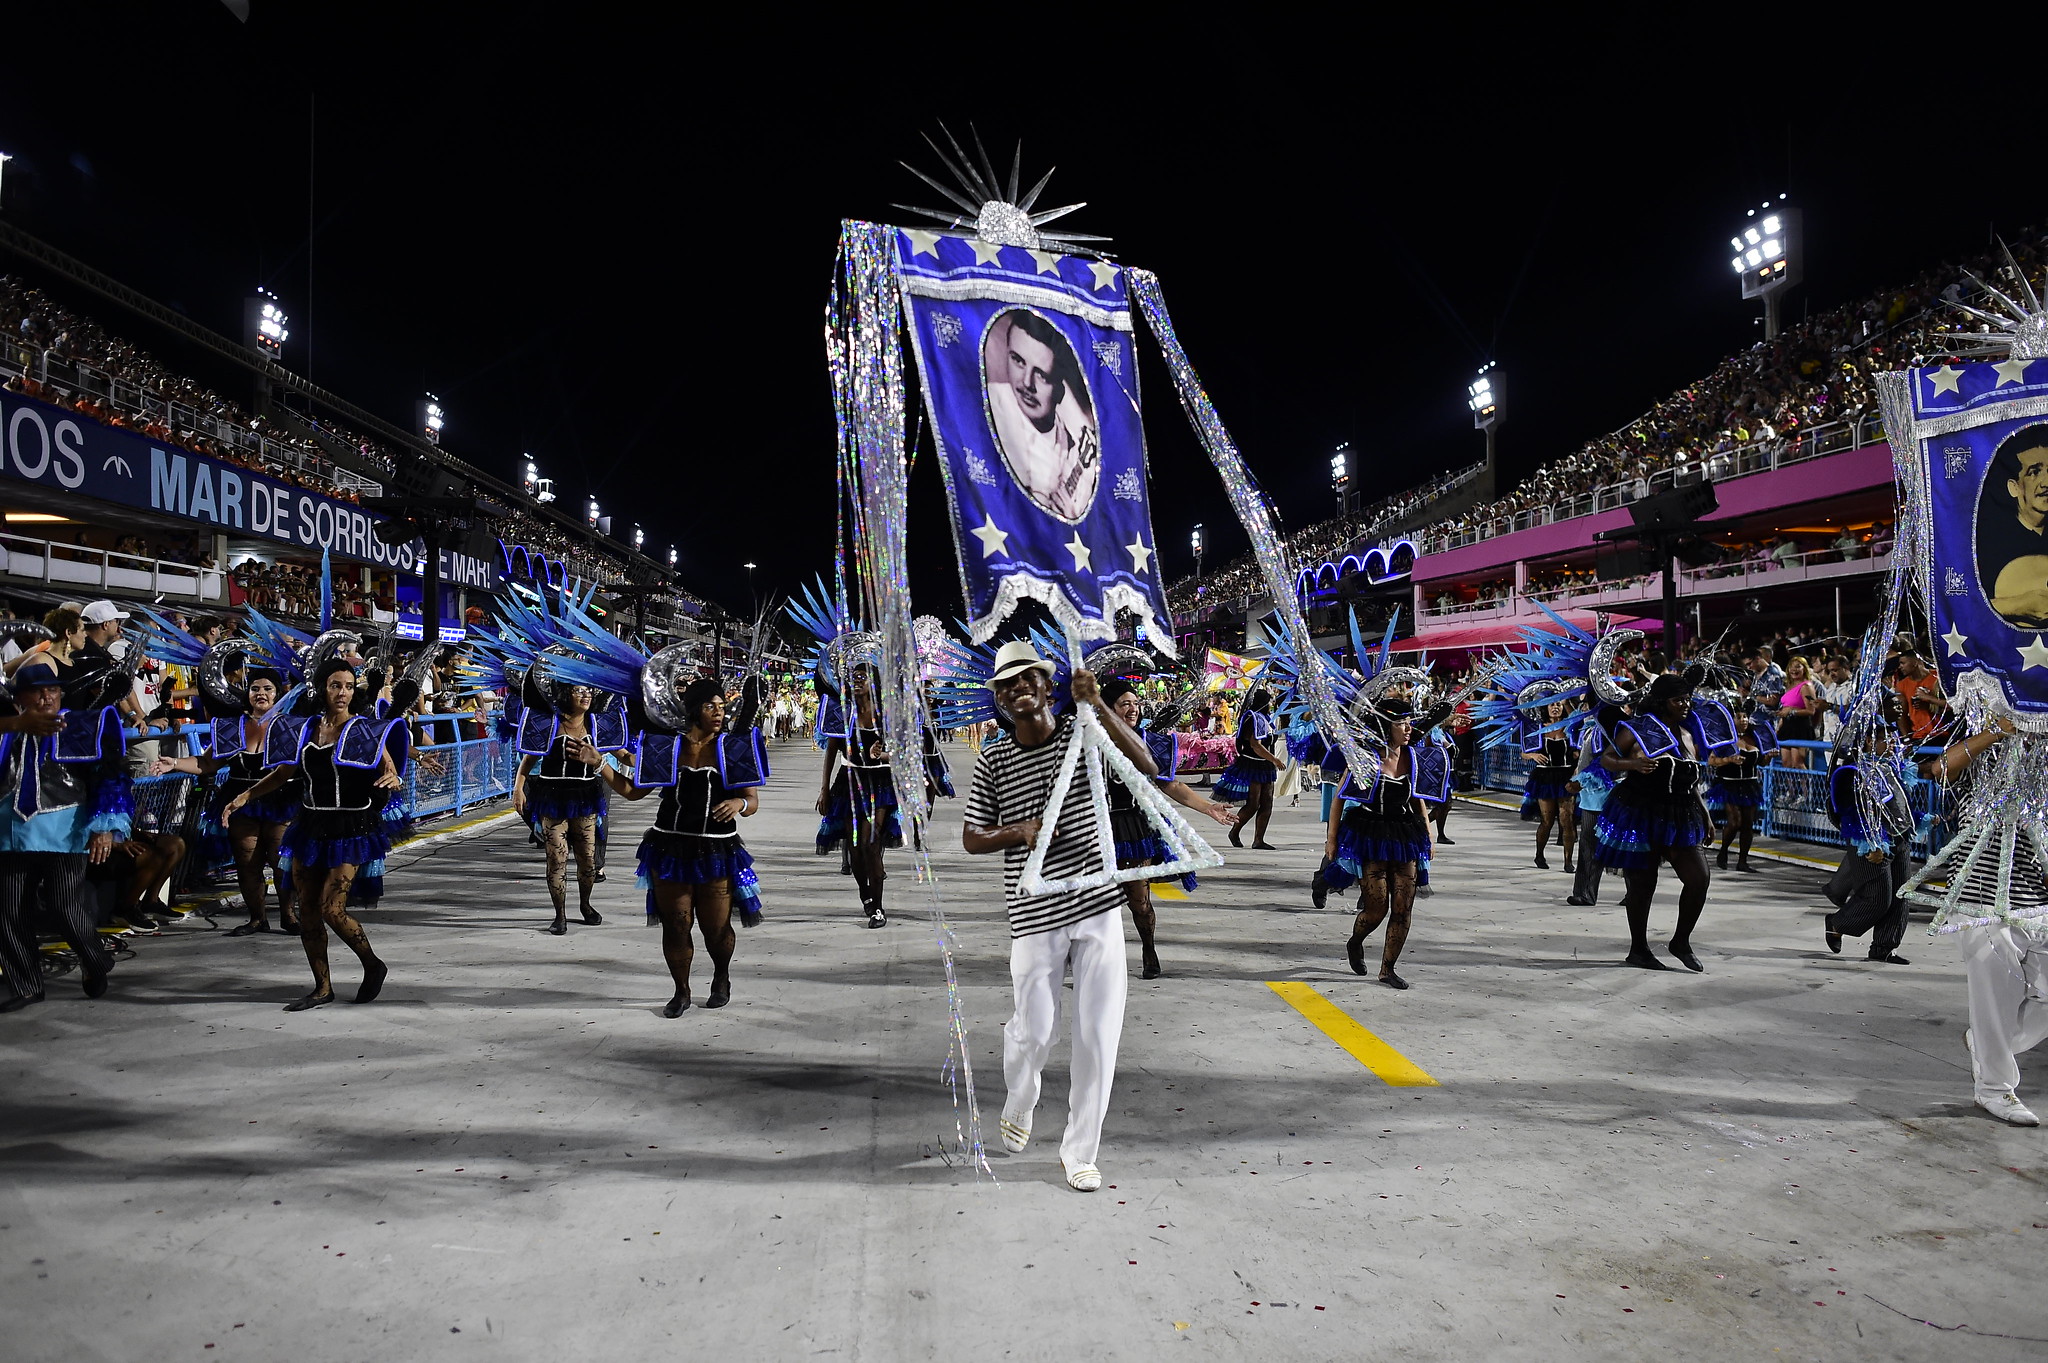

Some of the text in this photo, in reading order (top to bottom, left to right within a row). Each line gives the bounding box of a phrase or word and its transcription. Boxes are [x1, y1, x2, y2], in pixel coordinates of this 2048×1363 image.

[150, 447, 243, 529] MAR
[251, 480, 290, 539] DE
[452, 551, 491, 589] MAR!
